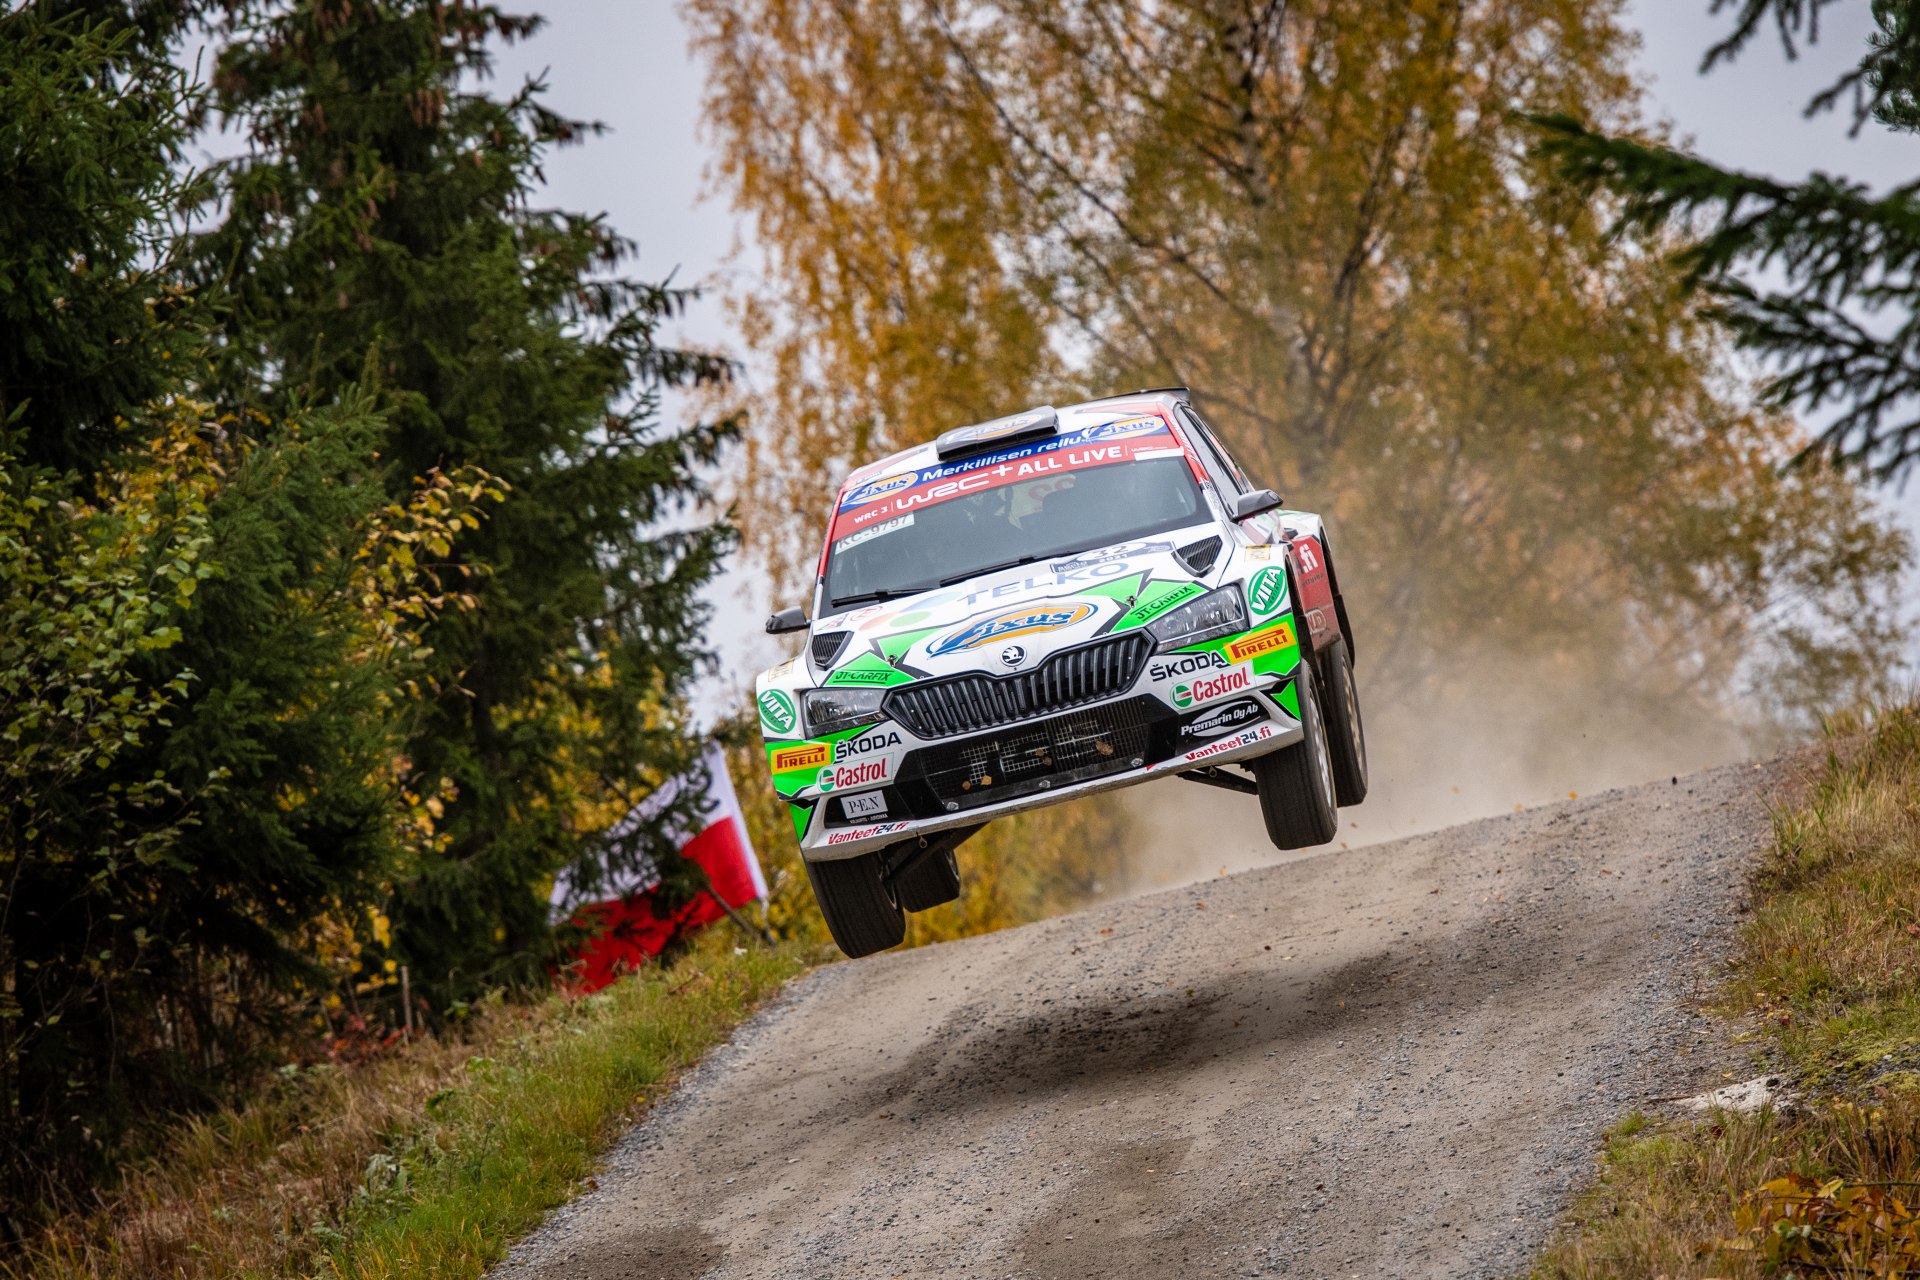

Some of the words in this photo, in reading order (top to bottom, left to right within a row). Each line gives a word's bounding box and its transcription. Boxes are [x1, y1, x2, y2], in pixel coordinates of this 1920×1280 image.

[922, 446, 1032, 482] Merkillisen
[1017, 457, 1063, 476] ALL
[1068, 446, 1123, 465] LIVE
[854, 509, 879, 524] WRC
[881, 505, 889, 514] 3
[1091, 545, 1129, 558] 32
[957, 562, 1130, 606] TELKO
[1250, 568, 1282, 611] VIITA
[928, 607, 1078, 658] Fixus
[1230, 628, 1288, 659] PIRELLI
[1149, 650, 1226, 682] ŠKODA
[1193, 666, 1250, 702] Castrol
[759, 691, 795, 730] VIITA
[1181, 713, 1232, 736] Premarin
[1245, 703, 1259, 715] Ab
[776, 746, 825, 769] PIRELLI
[835, 731, 903, 759] ŠKODA
[1184, 725, 1273, 760] Vanteet24.fi
[835, 757, 888, 788] Castrol
[828, 821, 910, 845] Vanteet24.fi
